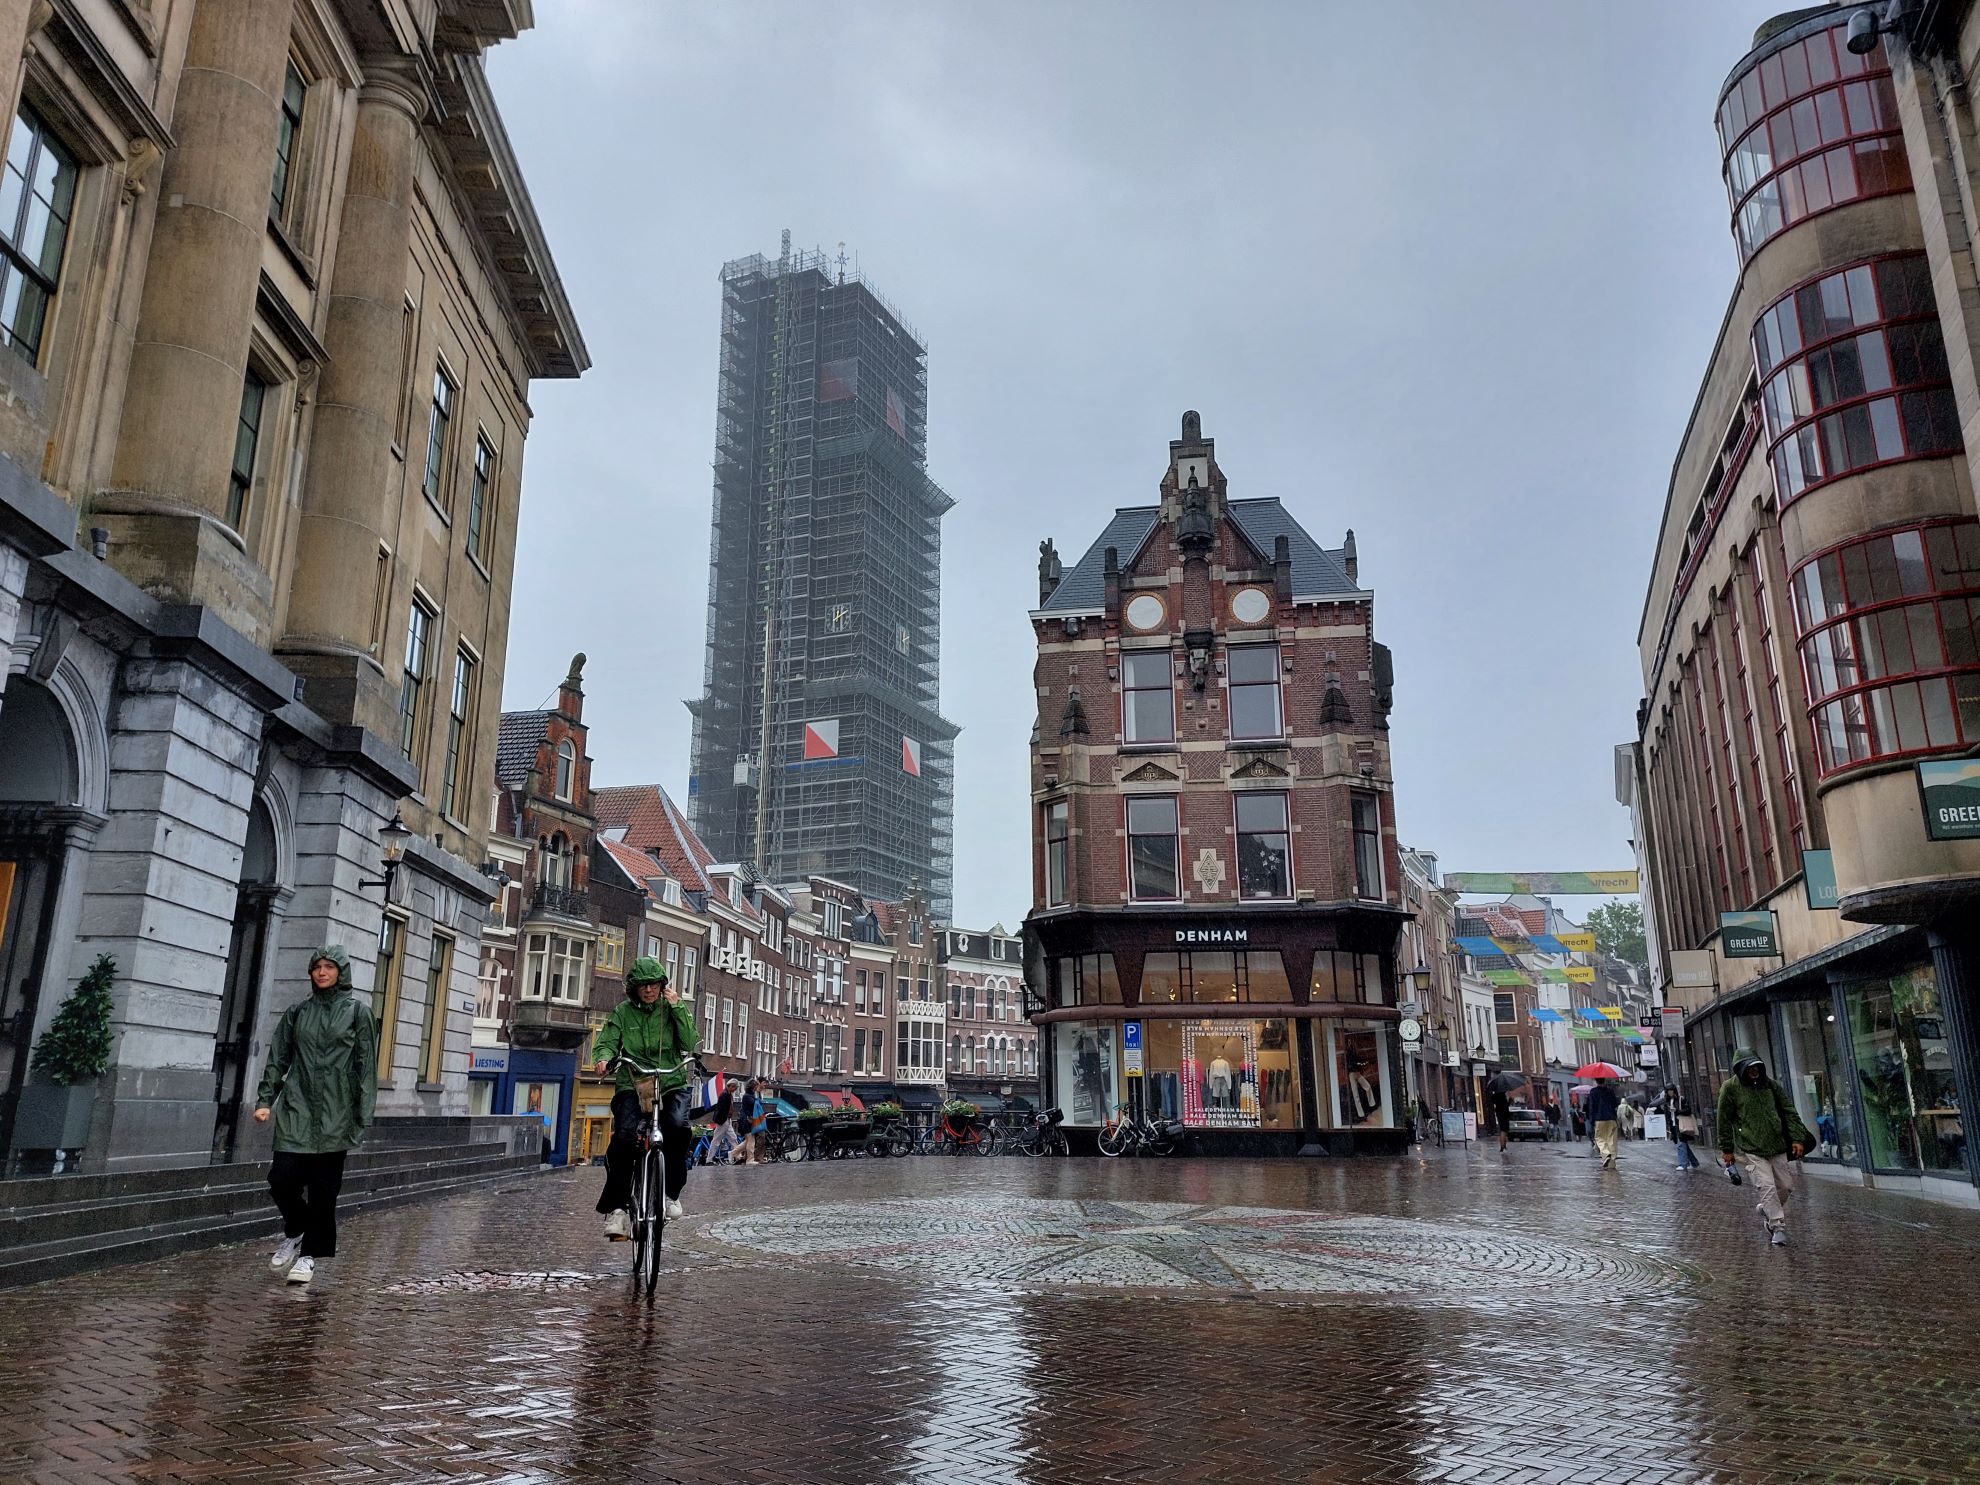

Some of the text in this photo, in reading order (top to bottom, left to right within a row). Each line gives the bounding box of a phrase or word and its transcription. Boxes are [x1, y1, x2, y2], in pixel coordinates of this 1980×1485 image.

[1175, 930, 1247, 941] DENHAM
[1127, 1026, 1136, 1038] P
[475, 1058, 504, 1068] LIESTING
